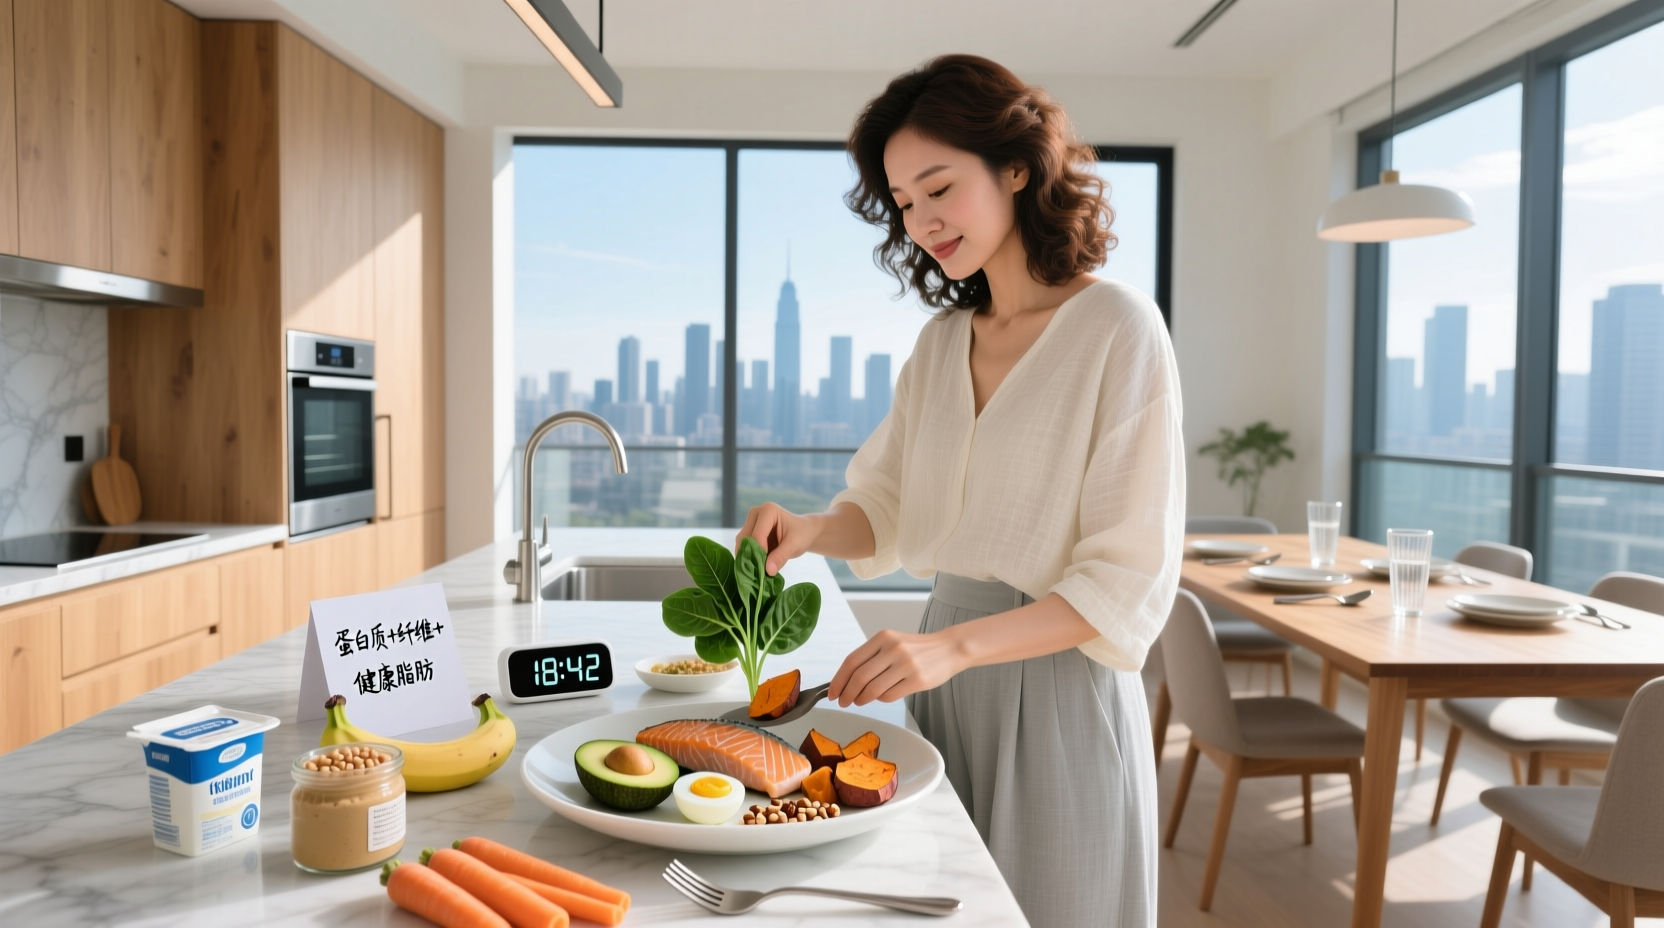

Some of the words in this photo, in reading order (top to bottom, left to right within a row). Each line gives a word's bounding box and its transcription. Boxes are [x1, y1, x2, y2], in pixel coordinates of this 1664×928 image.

[334, 618, 444, 657] 蛋白质+纤维+
[353, 658, 434, 695] 健康脂肪
[534, 653, 600, 686] 18:42
